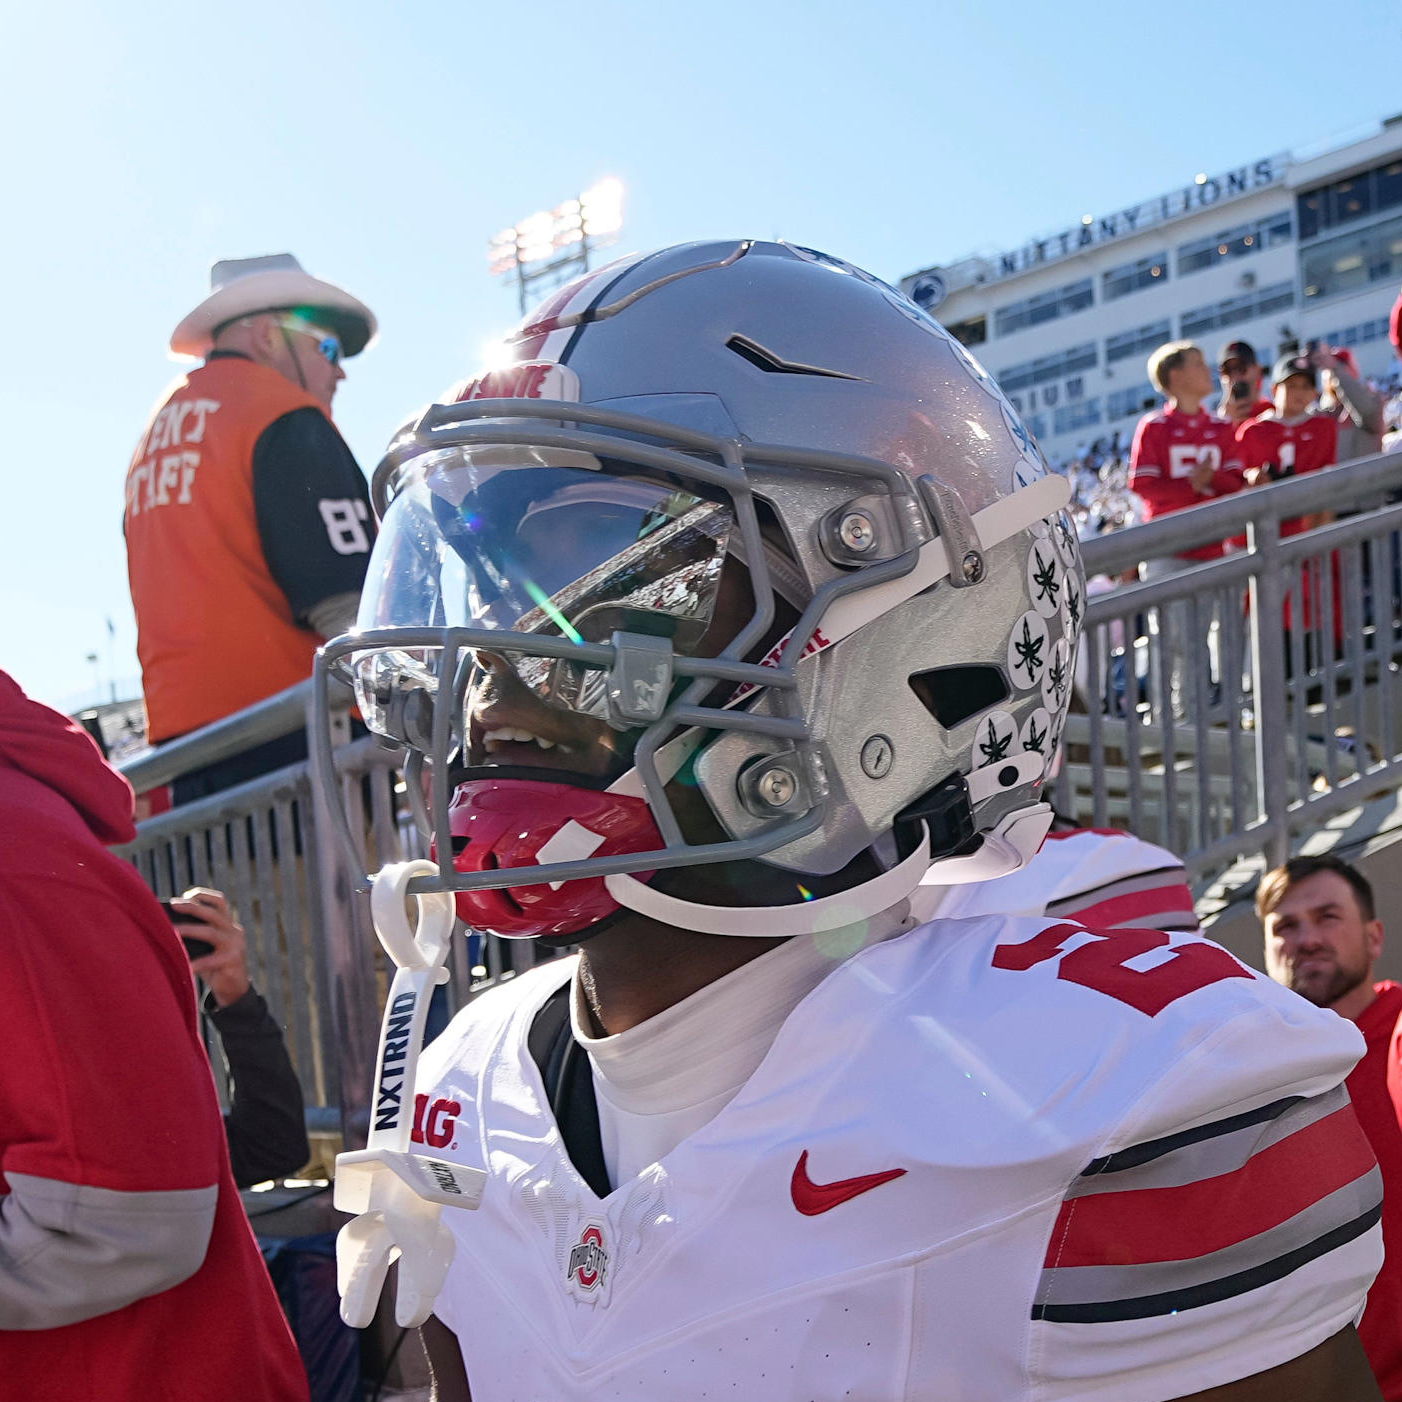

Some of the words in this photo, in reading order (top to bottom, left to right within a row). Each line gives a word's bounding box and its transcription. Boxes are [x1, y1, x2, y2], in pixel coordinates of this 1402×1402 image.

[1000, 206, 1141, 275] NITTANY
[1161, 159, 1273, 219] LIONS
[148, 398, 220, 453] ENT
[127, 451, 200, 517] TAFF
[375, 991, 417, 1131] NXTRND
